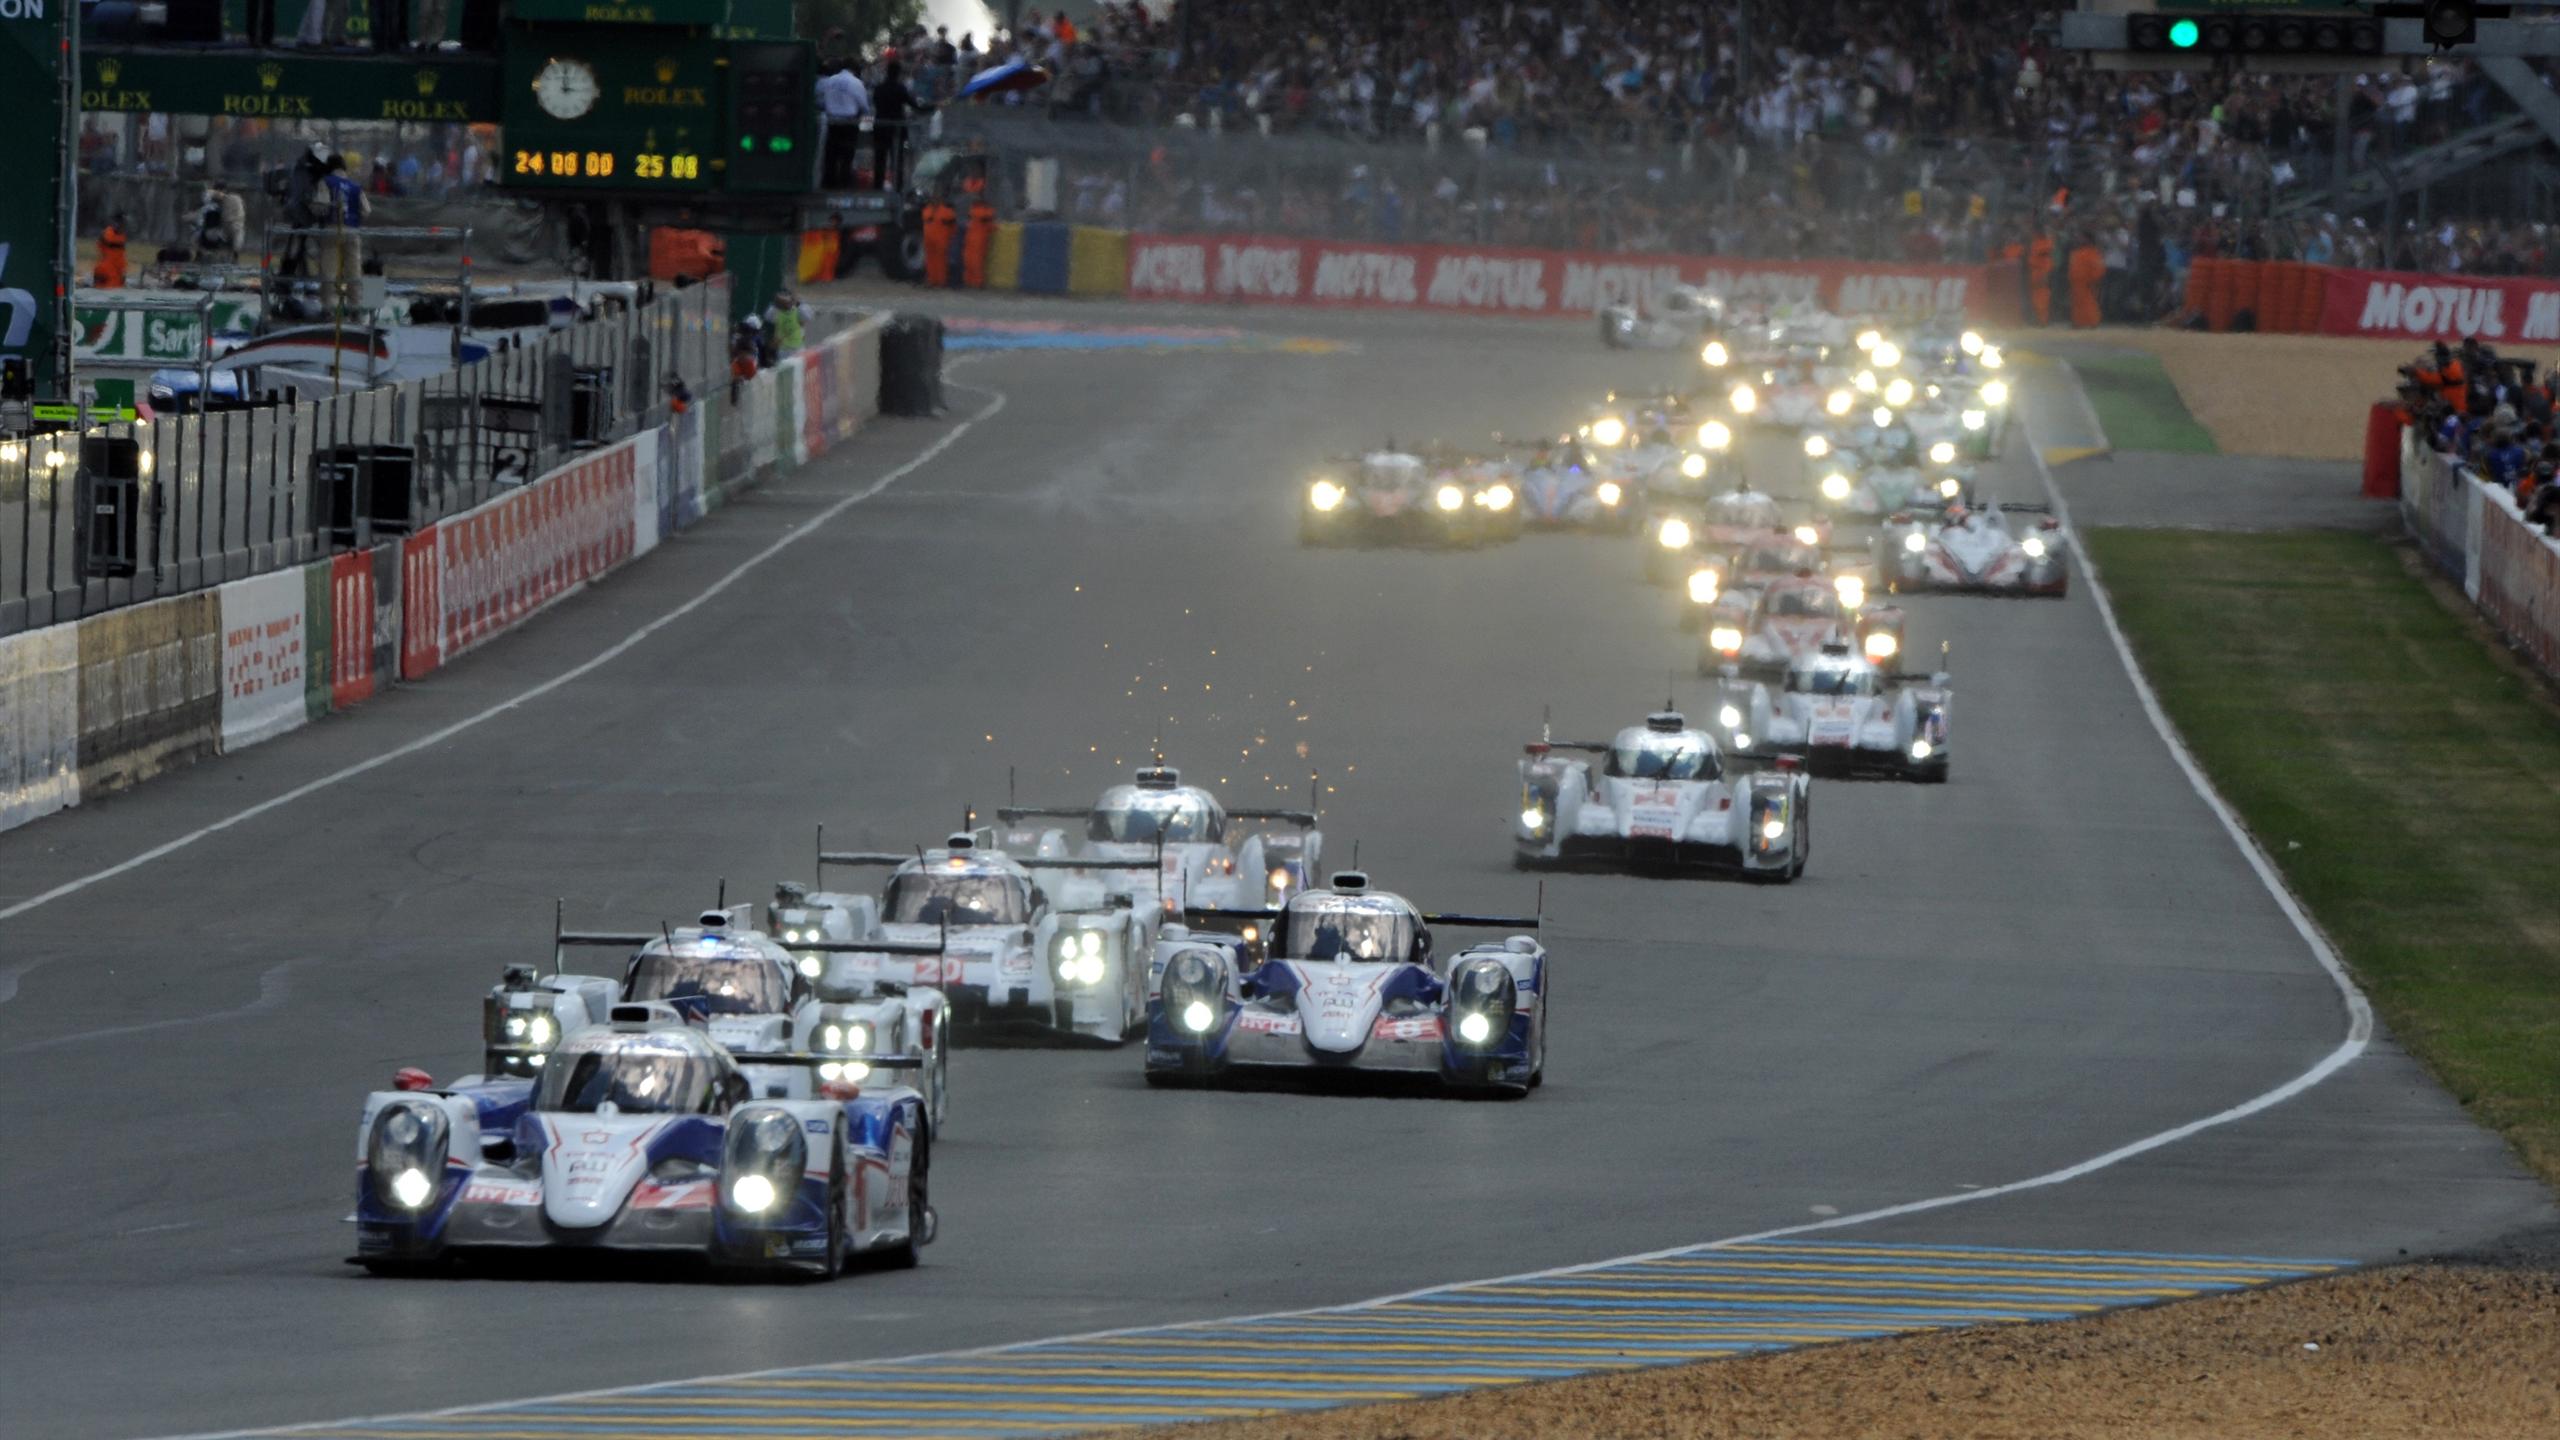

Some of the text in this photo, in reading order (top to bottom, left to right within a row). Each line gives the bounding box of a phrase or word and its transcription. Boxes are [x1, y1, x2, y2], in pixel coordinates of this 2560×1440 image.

[82, 91, 151, 110] OLEX
[222, 95, 312, 116] ROLEX
[623, 86, 706, 107] ROLEX
[382, 98, 468, 119] ROLEX
[515, 151, 545, 174] 24
[1312, 250, 1418, 303] MOTUL
[1427, 256, 1548, 310] MOTUL
[2361, 281, 2505, 337] MOTUL
[495, 447, 526, 484] 2
[917, 959, 963, 982] 20
